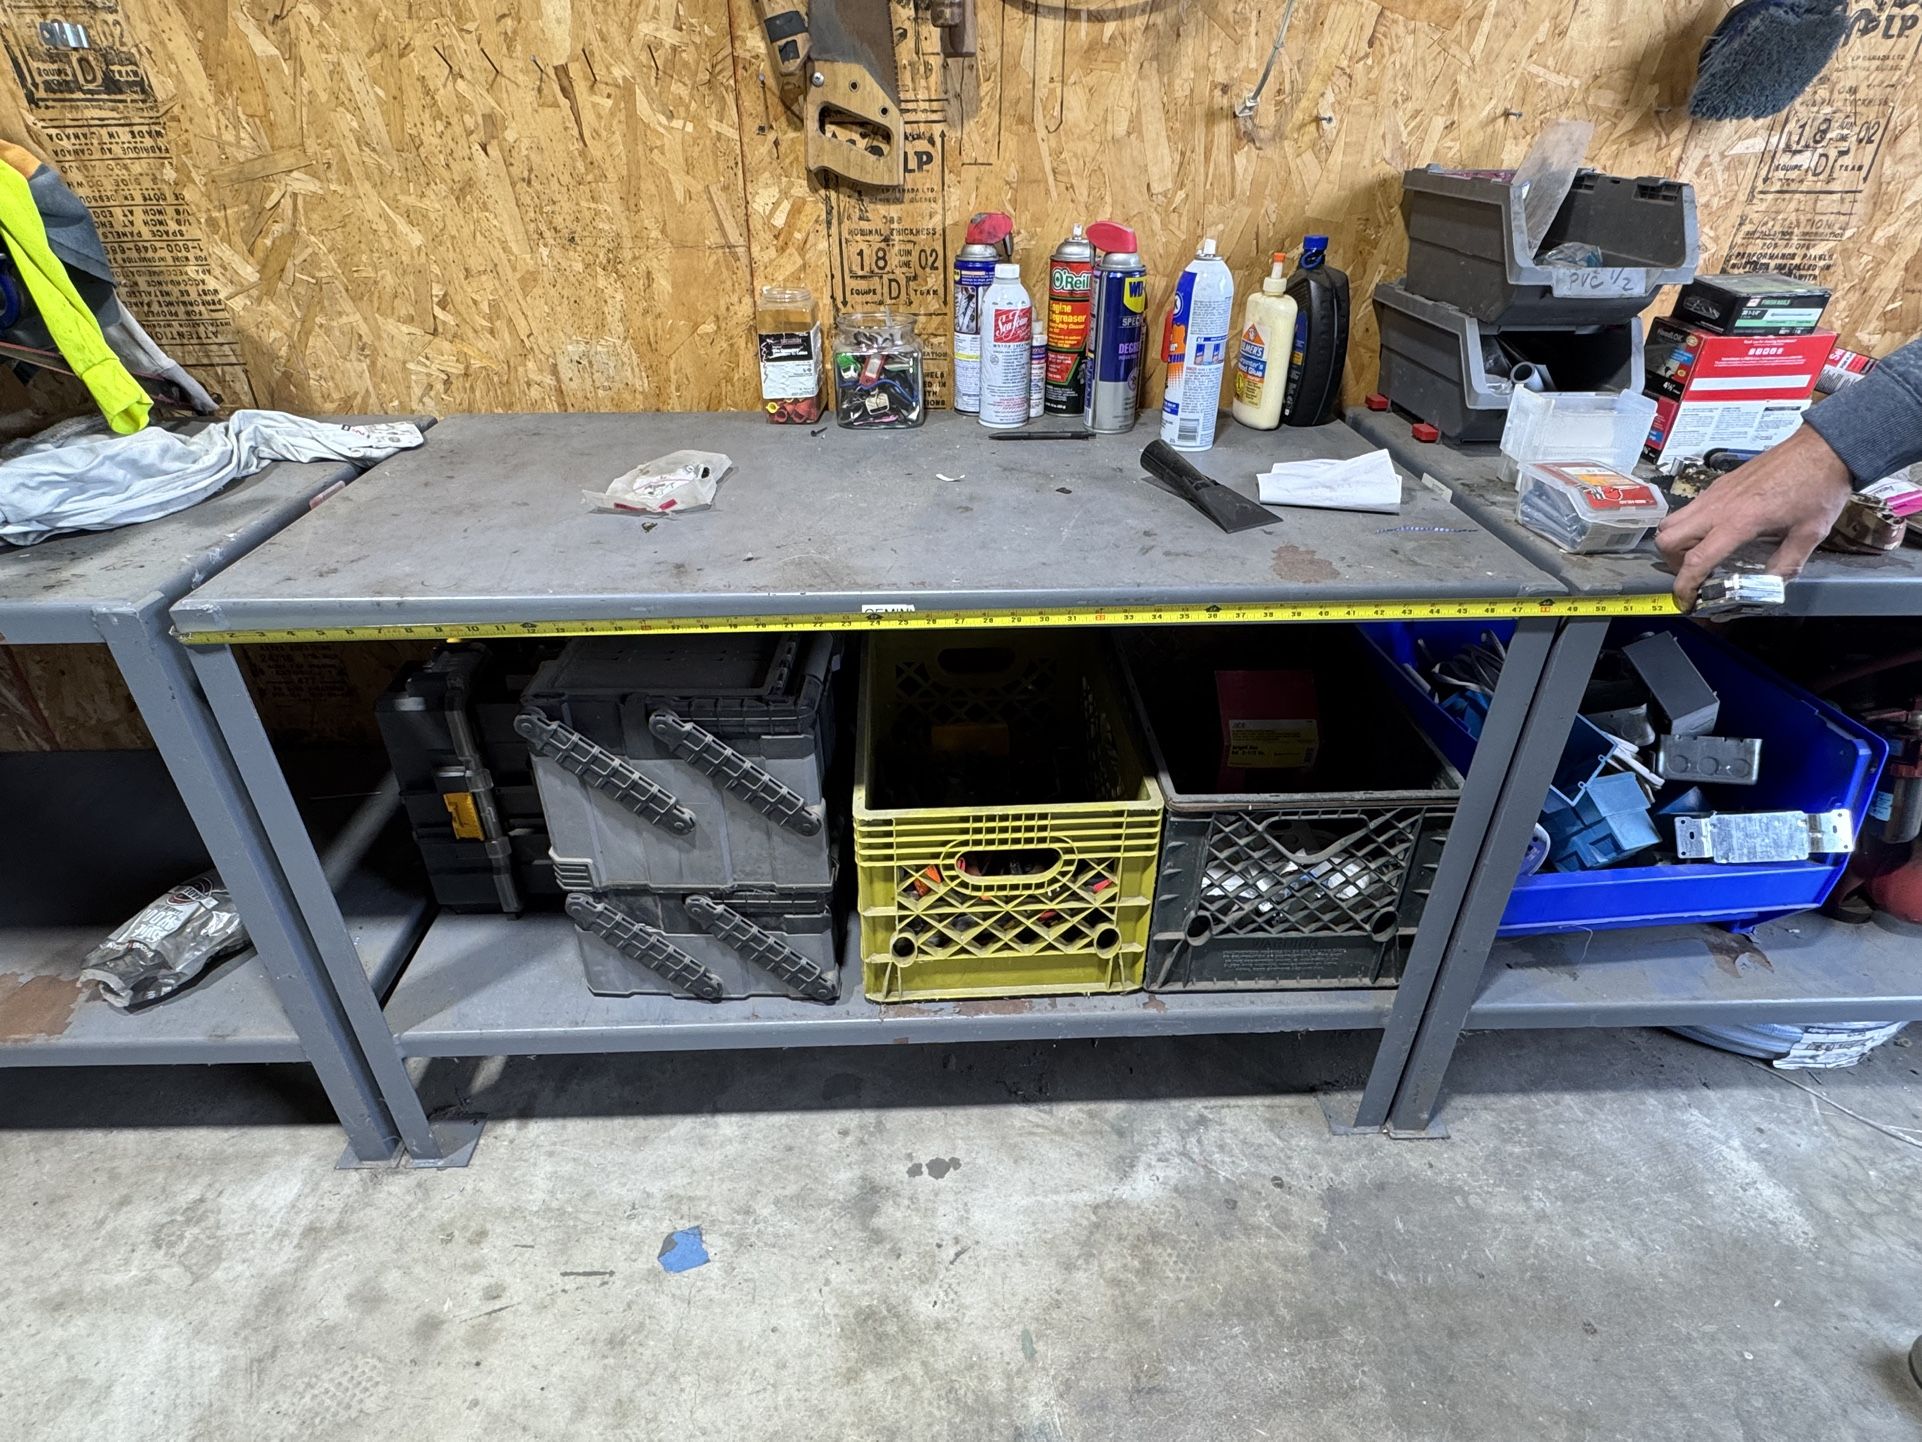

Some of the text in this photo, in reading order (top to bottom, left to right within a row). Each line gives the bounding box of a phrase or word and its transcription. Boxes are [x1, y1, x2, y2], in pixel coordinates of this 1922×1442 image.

[77, 56, 97, 84] D
[107, 131, 120, 140] IN
[130, 130, 164, 140] MADE
[1855, 120, 1881, 145] 02
[52, 148, 94, 157] CANADA
[100, 147, 112, 156] AU
[1775, 153, 1865, 178] EQUIPE D TEAM
[78, 194, 117, 204] DESSOU
[172, 192, 185, 202] CE
[92, 209, 113, 219] EDG
[121, 208, 134, 217] AT
[143, 208, 167, 218] INCH
[121, 219, 134, 228] AT
[142, 218, 168, 227] INCH
[101, 229, 185, 240] SPACE PANELS
[847, 227, 938, 237] NOMINAL THICKNESS
[194, 255, 208, 264] FOR
[917, 248, 939, 272] 02
[1734, 252, 1798, 262] PERFORMANCE
[112, 269, 188, 279] RECOMMENDATIO
[1052, 267, 1091, 291] O'Reil
[145, 278, 206, 288] ACCORDANCE
[1569, 271, 1604, 289] PVC
[125, 288, 218, 299] MUST BE INSTALLED
[850, 288, 877, 297] EQUIPE
[888, 278, 902, 301] D
[121, 299, 222, 309] PERFORMANCE PANEL
[143, 309, 203, 319] FOR PROPER
[177, 321, 232, 329] INSTALLATION
